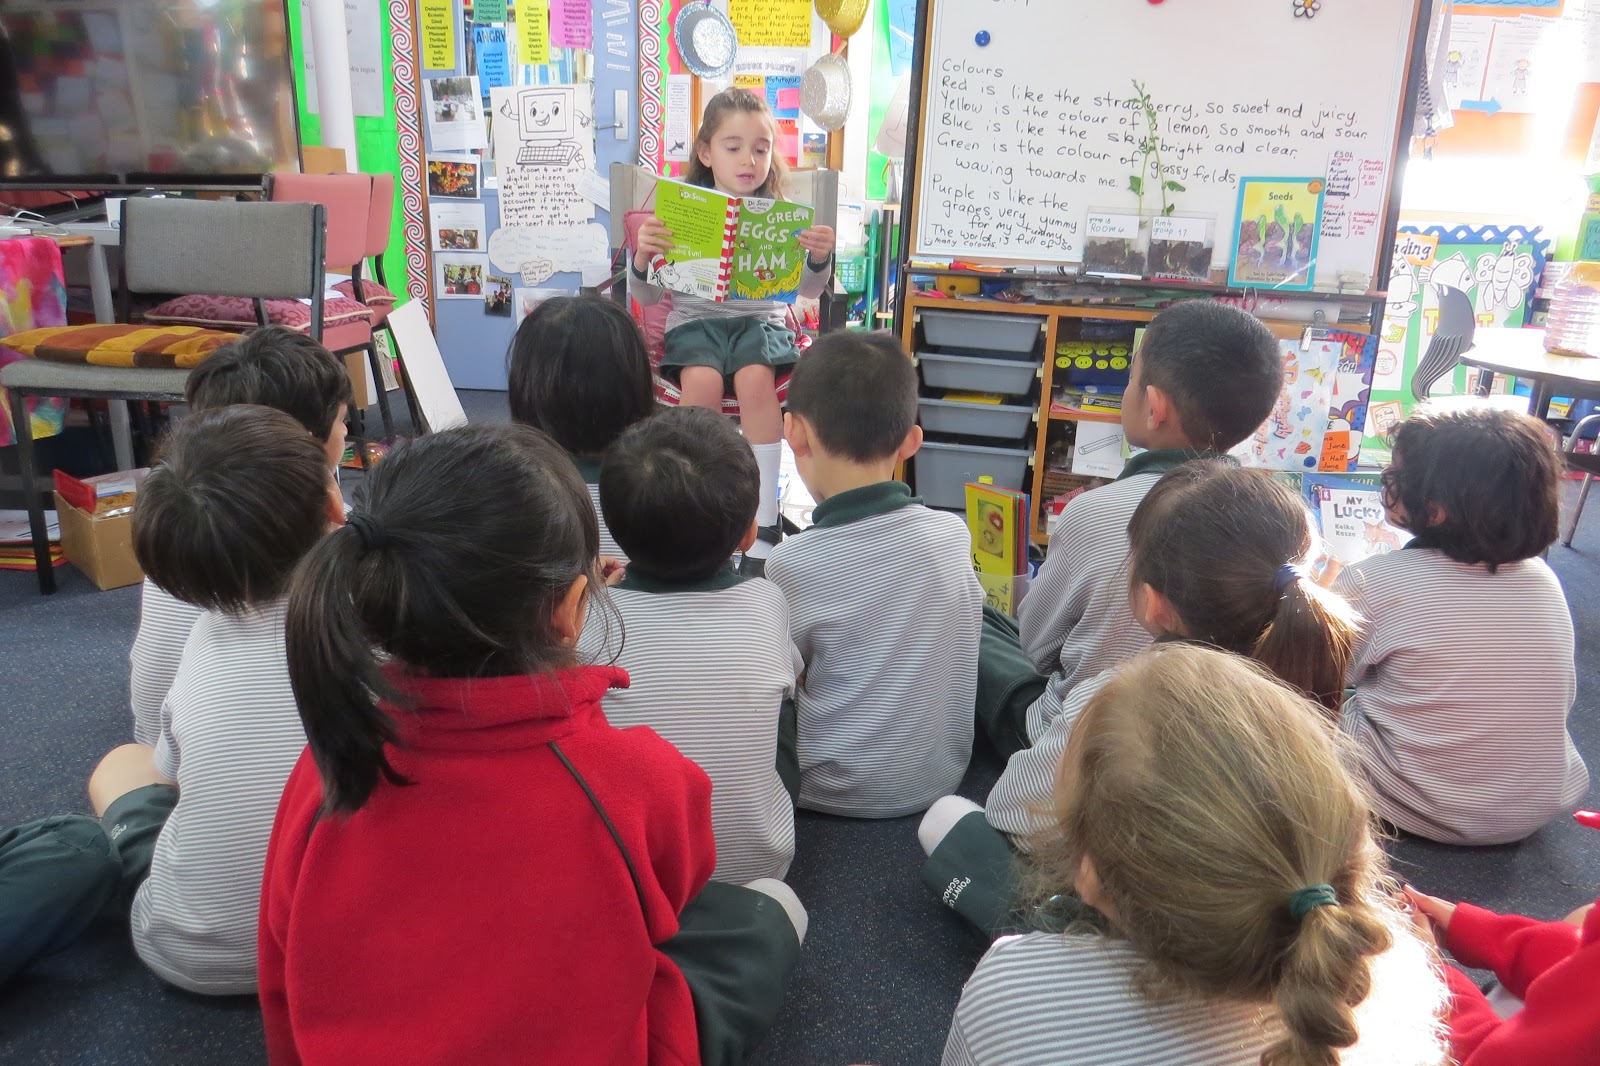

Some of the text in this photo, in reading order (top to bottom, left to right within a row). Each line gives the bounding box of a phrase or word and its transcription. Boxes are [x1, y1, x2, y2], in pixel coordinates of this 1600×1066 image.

[754, 4, 765, 13] for
[736, 13, 752, 22] They
[941, 58, 1004, 78] Colours
[942, 76, 968, 91] Red
[981, 84, 995, 95] is
[1012, 85, 1044, 102] like
[1054, 89, 1080, 105] the
[1232, 98, 1269, 114] sweet
[1276, 103, 1304, 118] and
[1312, 104, 1359, 128] juicy.
[941, 91, 983, 114] Yellow
[995, 101, 1010, 116] is
[1023, 104, 1048, 119] the
[1058, 108, 1109, 124] colour
[1119, 111, 1141, 131] of
[1149, 122, 1158, 131] a
[1167, 117, 1210, 139] lemon,
[1246, 124, 1290, 138] smooth
[1300, 127, 1325, 140] and
[1335, 128, 1368, 140] sour.
[941, 113, 973, 131] Blue
[986, 119, 1001, 132] is
[1016, 119, 1044, 136] like
[1058, 123, 1087, 139] the
[1160, 138, 1203, 160] bright
[1214, 138, 1245, 154] and
[1255, 141, 1298, 159] clear.
[937, 132, 980, 151] Green
[992, 139, 1008, 153] is
[1017, 139, 1044, 156] the
[1056, 144, 1112, 161] colour
[1120, 150, 1142, 168] of
[1150, 161, 1189, 180] grassy
[520, 166, 541, 174] Room
[955, 157, 1119, 187] waving towards me.
[506, 175, 530, 185] digital
[534, 183, 550, 192] help
[564, 182, 575, 190] log
[932, 173, 1069, 211] Purple is like the
[550, 197, 565, 205] they
[1268, 192, 1293, 201] Seeds
[503, 205, 536, 215] forgotten
[549, 213, 560, 221] get
[766, 208, 810, 224] GREEN
[942, 200, 1077, 234] grapes, very yummy
[558, 219, 575, 227] help
[968, 214, 990, 229] for
[996, 223, 1013, 235] my
[740, 221, 790, 243] EGGS
[931, 223, 1055, 249] The world is full of
[1153, 227, 1174, 237] group
[934, 238, 957, 247] many
[738, 252, 786, 273] HAM
[1328, 442, 1346, 450] June
[1323, 461, 1339, 469] June
[1345, 496, 1363, 505] MY
[1333, 503, 1382, 520] LUCKY
[1335, 523, 1355, 531] Keiko
[951, 876, 971, 900] POINT
